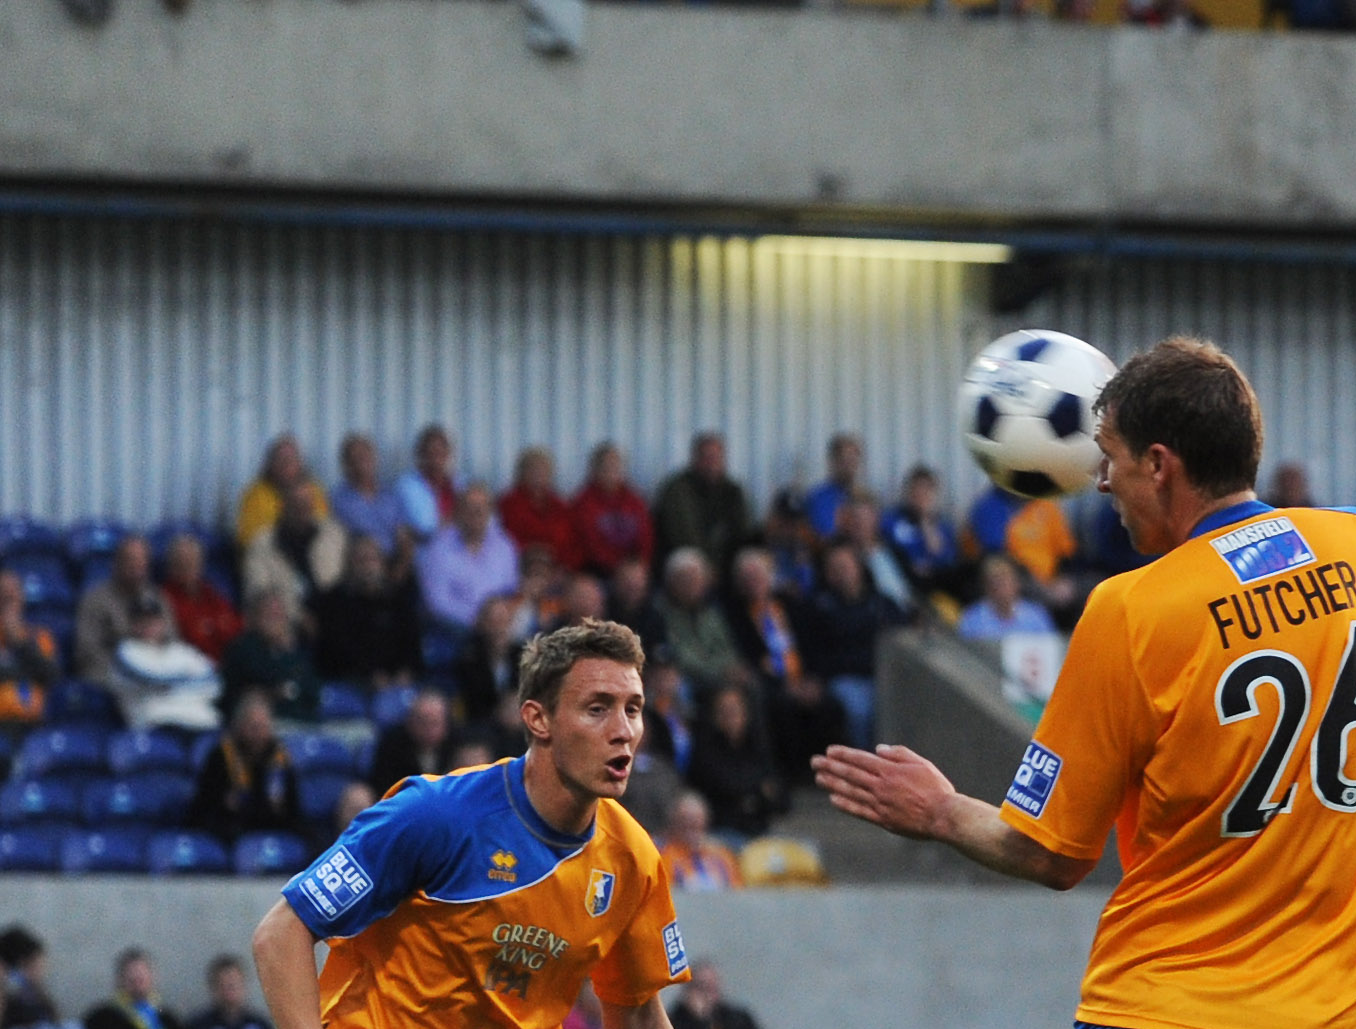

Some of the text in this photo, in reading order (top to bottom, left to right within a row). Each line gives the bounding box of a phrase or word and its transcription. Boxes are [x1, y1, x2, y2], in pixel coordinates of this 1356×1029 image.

[1213, 520, 1293, 554] MANSFIELD
[1022, 744, 1058, 777] LUE
[315, 862, 343, 894] SQ
[329, 851, 368, 895] BLUE
[492, 923, 569, 958] GREENE
[496, 943, 546, 970] KING
